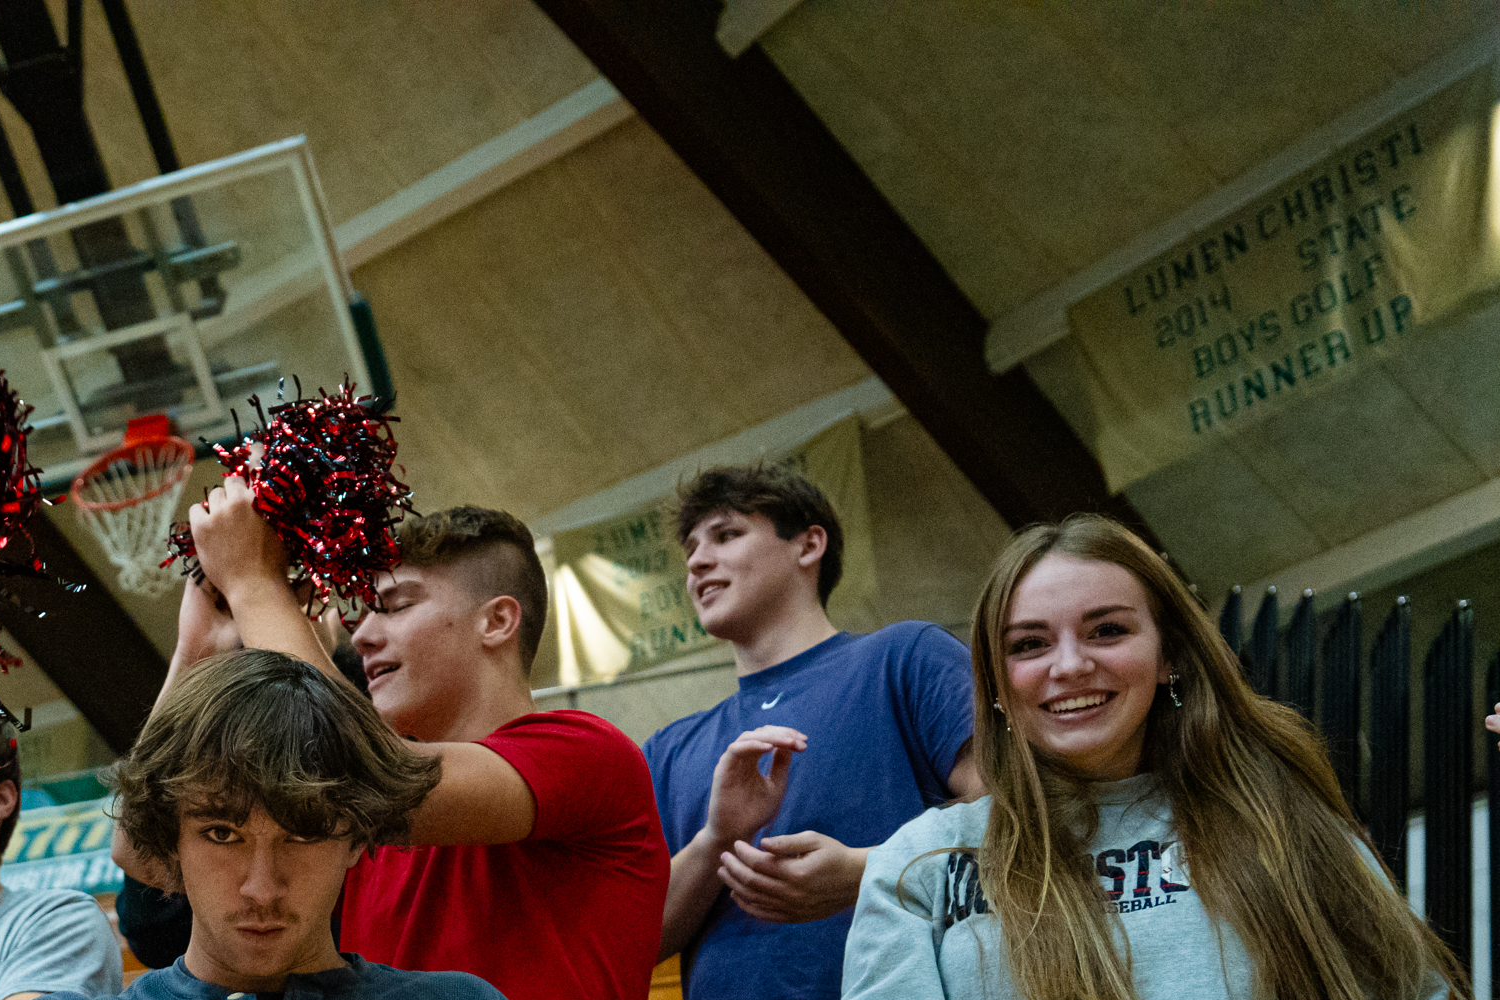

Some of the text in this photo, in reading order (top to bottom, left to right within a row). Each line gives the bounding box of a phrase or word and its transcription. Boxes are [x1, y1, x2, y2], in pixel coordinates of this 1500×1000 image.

[1123, 122, 1424, 316] LUMEN CHRISTI
[1154, 182, 1417, 349] 2014 STATE
[1188, 294, 1413, 435] RUNNER UP
[1192, 254, 1387, 379] BOYS GOLF
